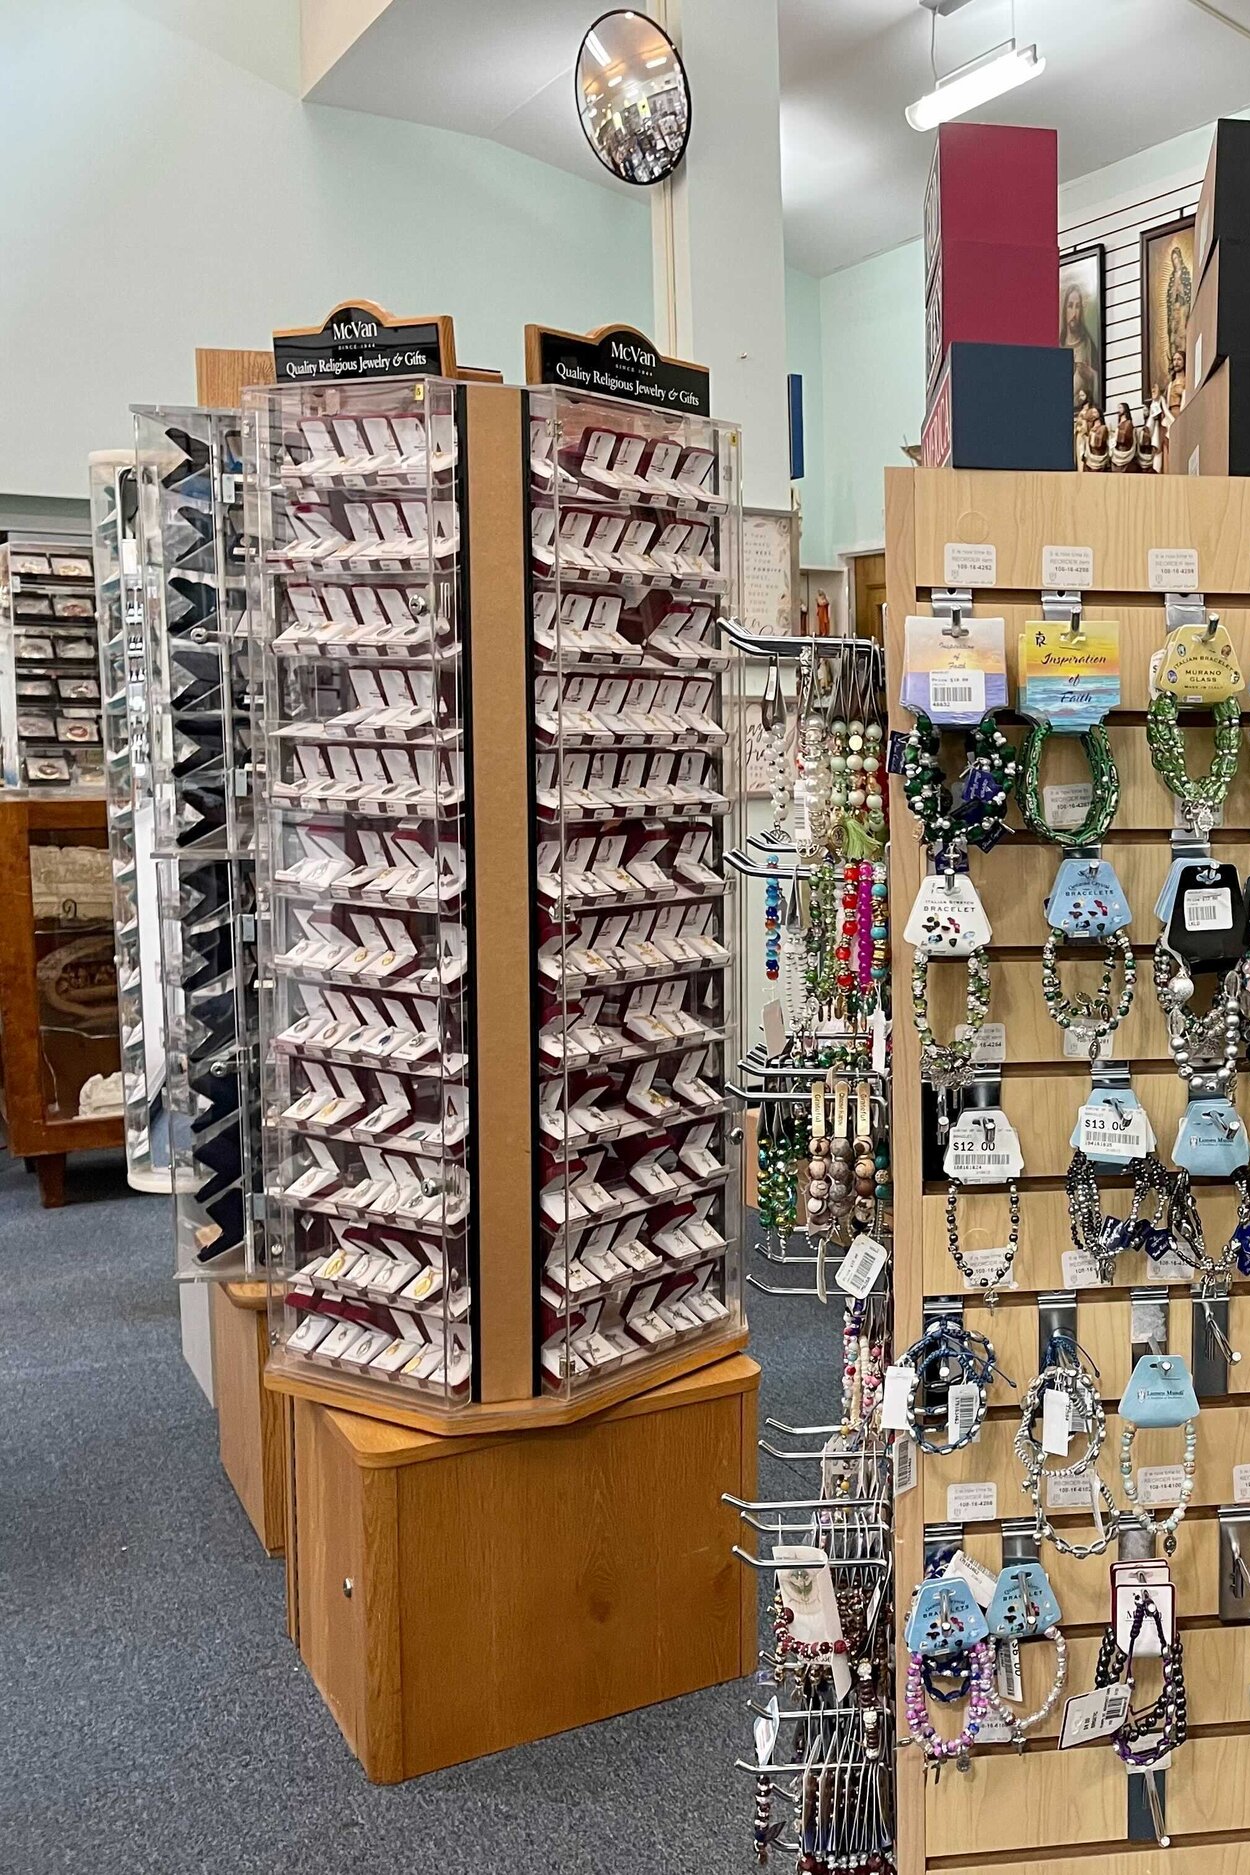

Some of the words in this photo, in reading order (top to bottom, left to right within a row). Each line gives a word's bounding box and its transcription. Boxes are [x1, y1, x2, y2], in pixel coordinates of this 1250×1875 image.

[333, 321, 378, 340] McVan
[611, 341, 656, 367] McVan
[286, 362, 316, 378] Quality
[318, 358, 357, 375] Religious
[358, 355, 390, 372] Jewelry
[392, 353, 403, 367] &
[404, 350, 426, 365] Gifts
[615, 364, 635, 373] SINCE
[556, 363, 592, 384] Quality
[593, 371, 634, 392] Religious
[634, 380, 666, 401] Jewelry
[668, 388, 678, 400] &
[679, 390, 700, 406] Gifts
[1041, 653, 1107, 666] Inspiration
[1173, 656, 1198, 670] ITALIAN
[1068, 674, 1080, 686] of
[1060, 691, 1092, 703] Faith
